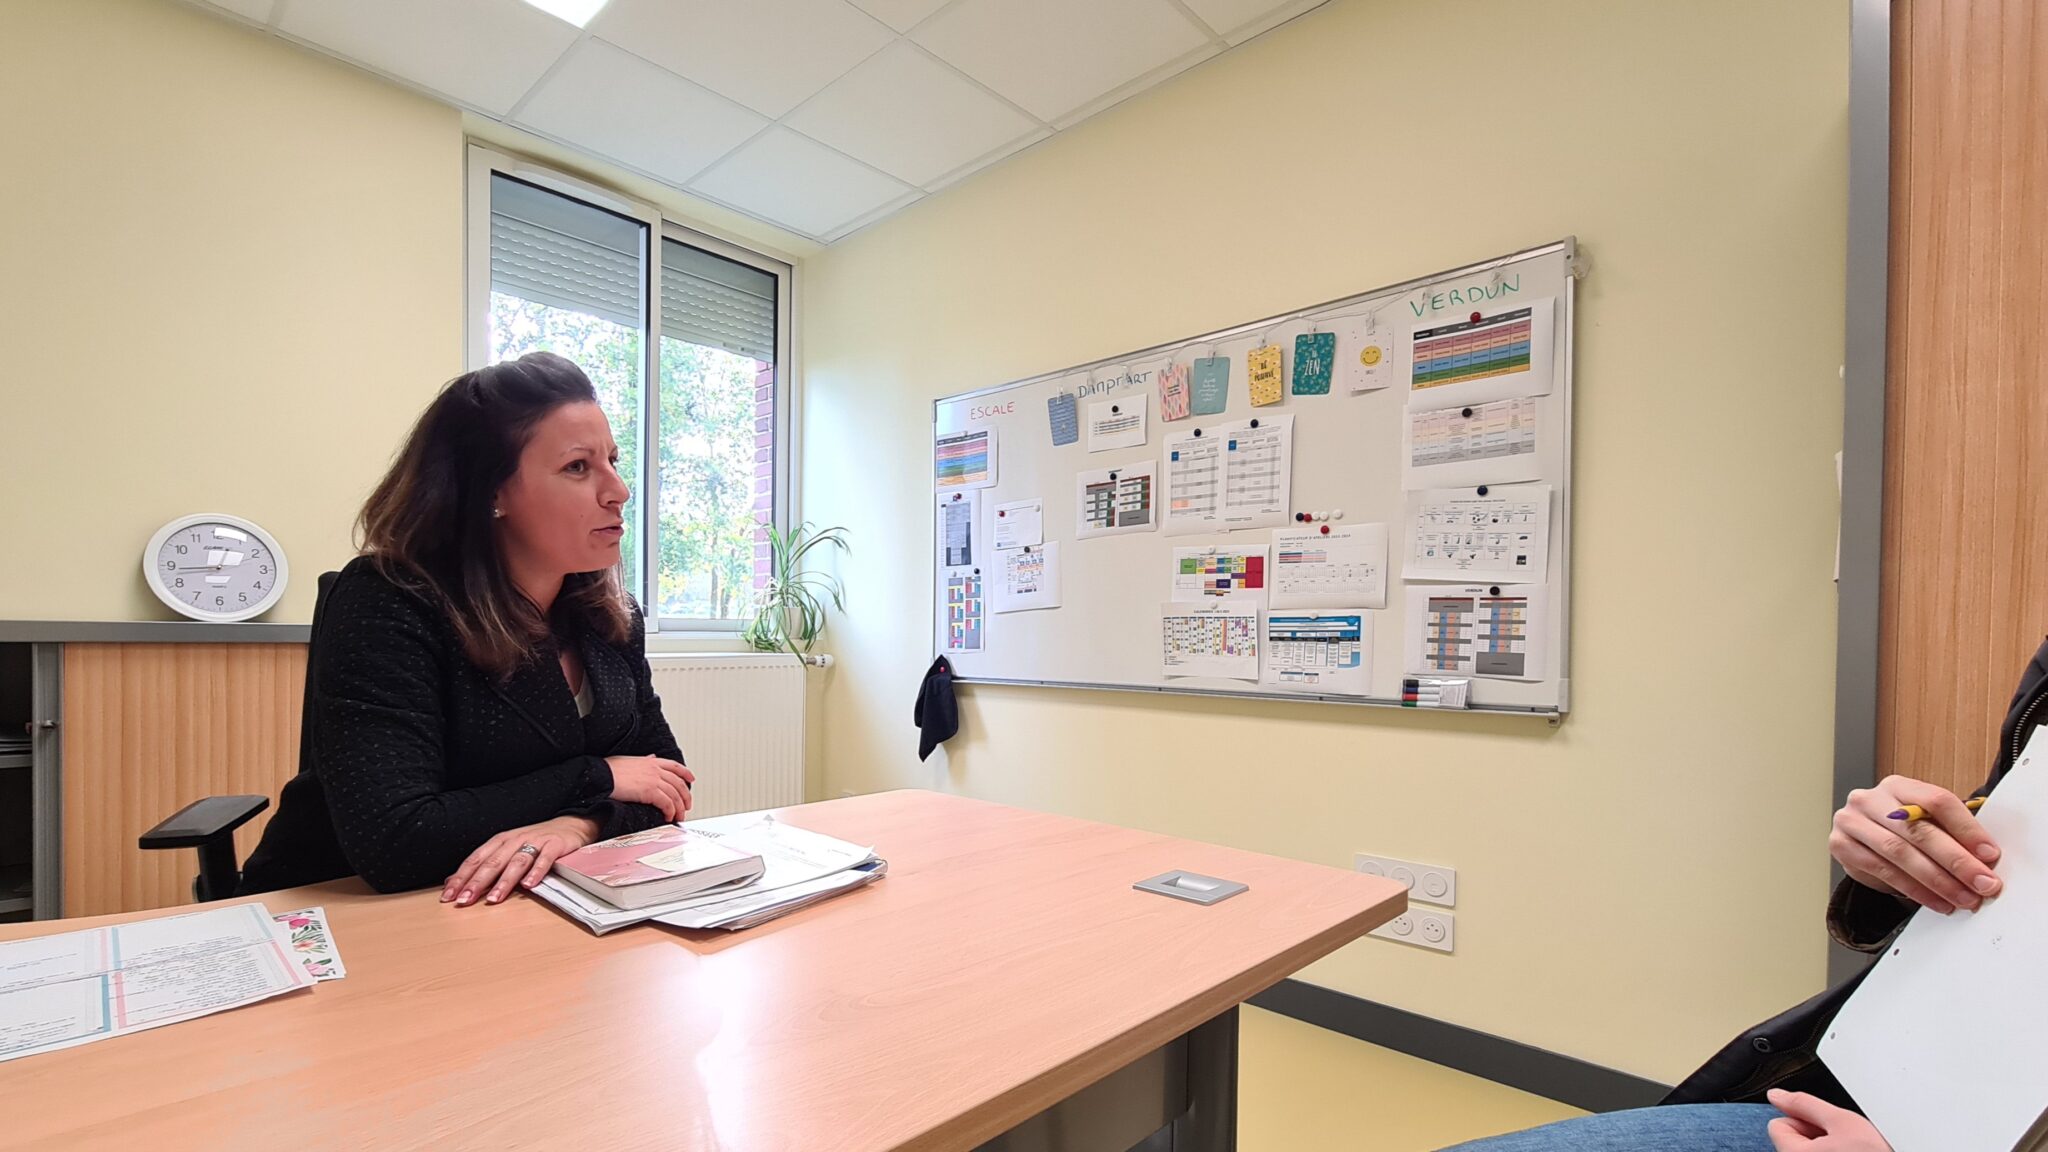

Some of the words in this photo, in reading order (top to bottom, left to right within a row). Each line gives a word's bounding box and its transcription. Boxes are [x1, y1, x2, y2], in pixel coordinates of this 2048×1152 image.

[1409, 273, 1520, 317] VERDUN
[1304, 358, 1321, 376] ZEN
[970, 401, 1015, 420] ESCALE
[190, 533, 201, 543] 11
[175, 544, 188, 555] 10
[251, 548, 260, 558] 2
[166, 560, 176, 570] 9
[259, 565, 268, 575] 3
[175, 578, 184, 588] 8
[253, 581, 262, 590] 4
[192, 591, 202, 601] 7
[215, 596, 224, 606] 6
[238, 592, 247, 602] 5
